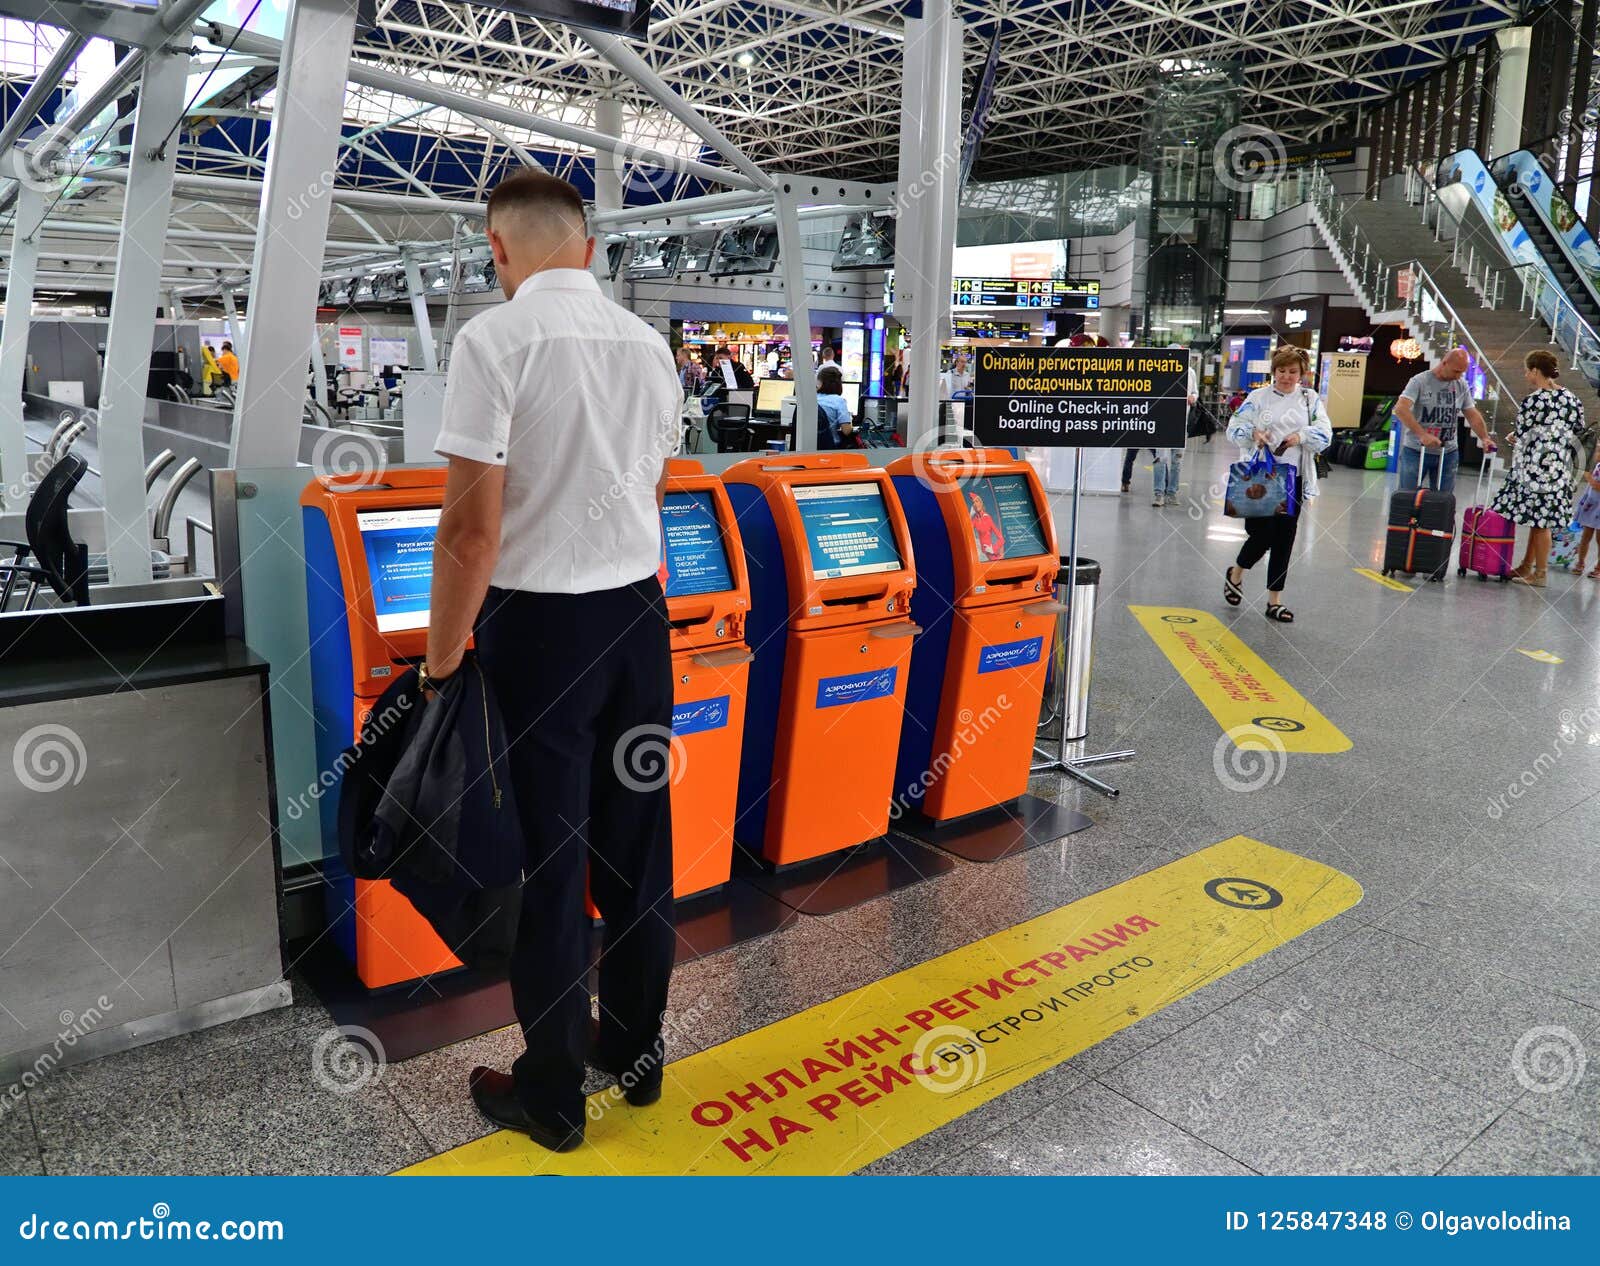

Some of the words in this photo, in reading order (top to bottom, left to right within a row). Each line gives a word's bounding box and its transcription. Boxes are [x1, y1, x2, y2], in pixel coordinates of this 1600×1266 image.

[983, 353, 1034, 371] Онлайн
[1038, 356, 1122, 374] регистрация
[1126, 359, 1134, 371] и
[1138, 359, 1184, 373] печать
[1337, 359, 1360, 368] Boft
[1009, 377, 1092, 393] посадочных
[1097, 378, 1152, 392] талонов
[1008, 400, 1054, 414] Online
[1058, 401, 1119, 414] Check-in
[1123, 401, 1149, 415] and
[999, 416, 1061, 432] boarding
[1065, 419, 1097, 432] pass
[1102, 417, 1156, 433] printing
[825, 681, 868, 693] АЭРОФЛОТ
[690, 914, 1161, 1127] ОНЛАЙН-РЕГИСТРАЦИЯ
[722, 1114, 814, 1163] НА
[806, 1051, 937, 1122] РЕЙС
[934, 1007, 1043, 1064] БЫСТРО
[1046, 996, 1068, 1013] И
[1063, 954, 1155, 1003] ПРОСТО
